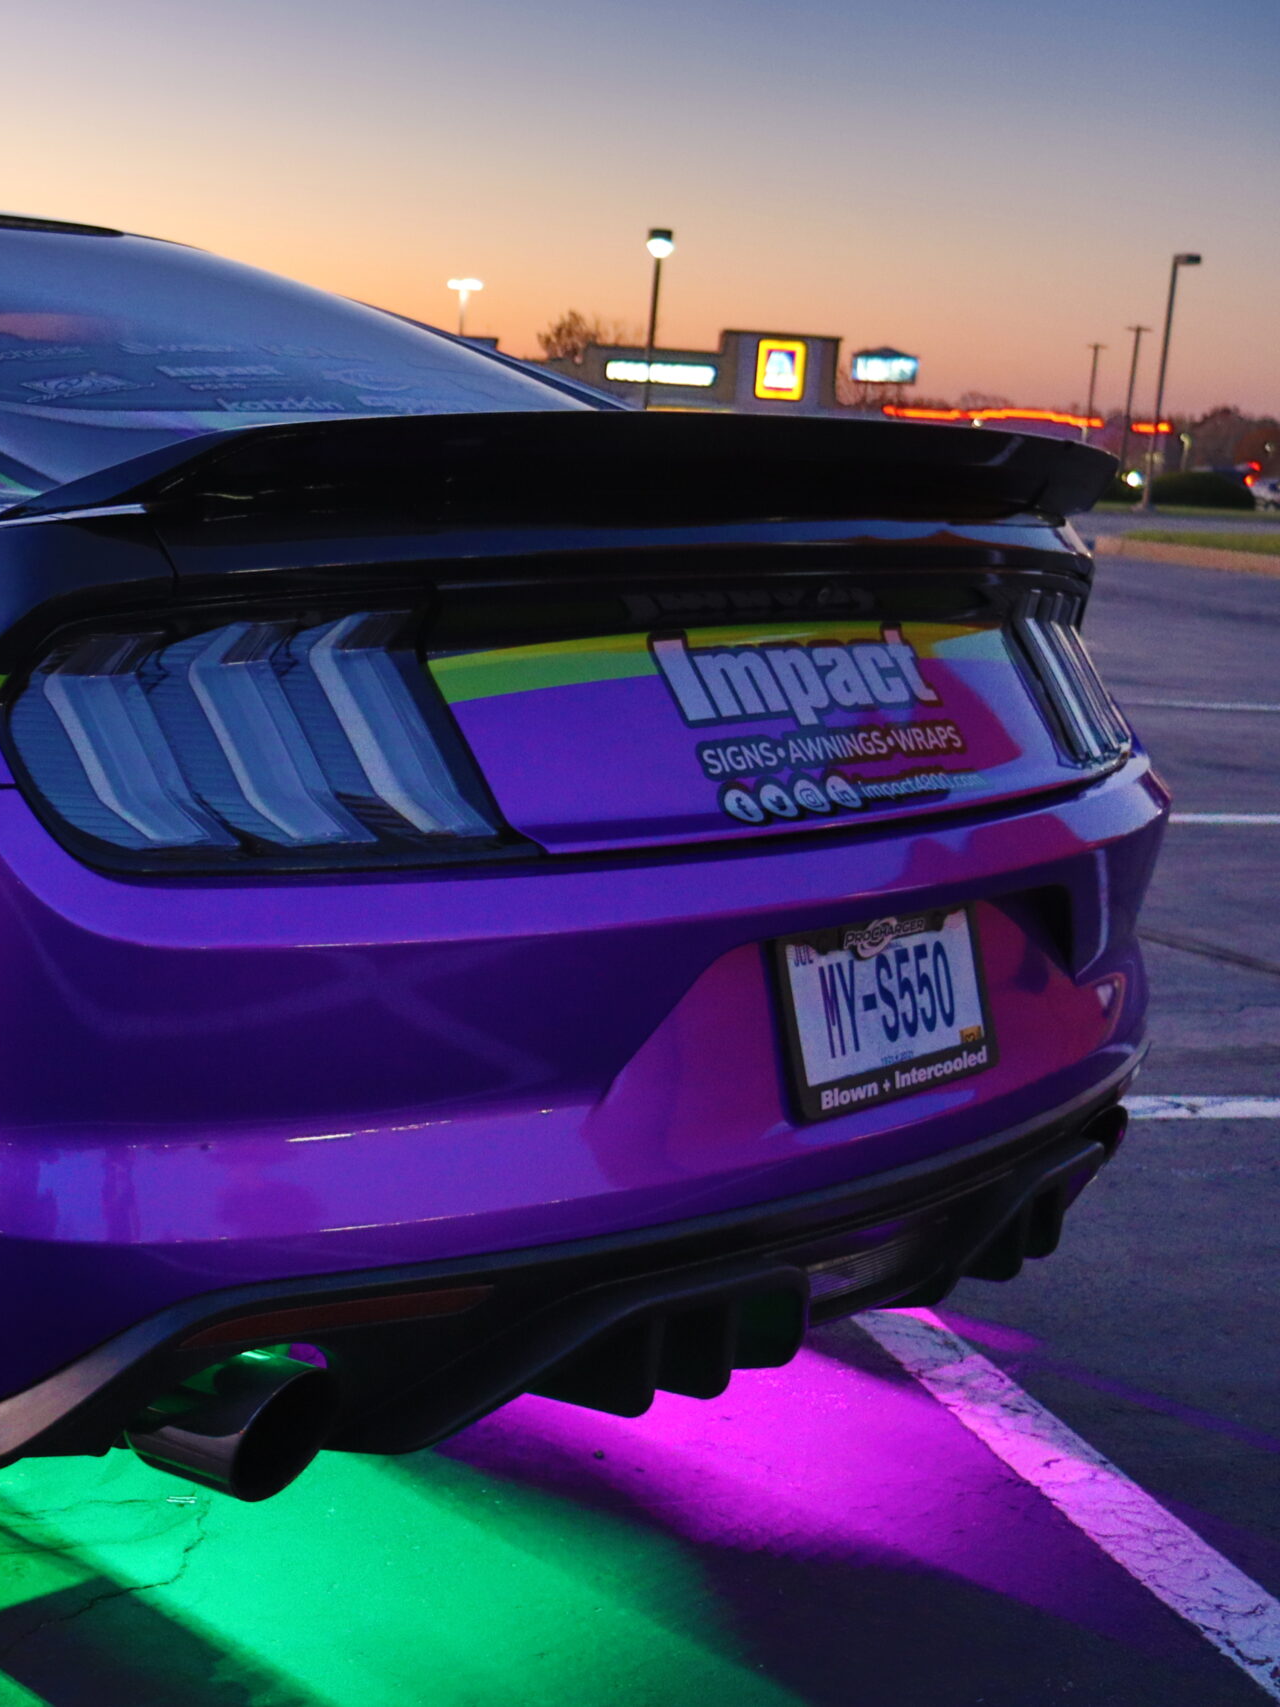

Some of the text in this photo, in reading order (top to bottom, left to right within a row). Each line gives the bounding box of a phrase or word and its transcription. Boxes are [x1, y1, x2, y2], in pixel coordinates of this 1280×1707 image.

[652, 629, 939, 727] Impact
[818, 940, 956, 1060] MY-S550
[820, 1080, 880, 1111] Blown
[894, 1045, 989, 1090] Intercooled
